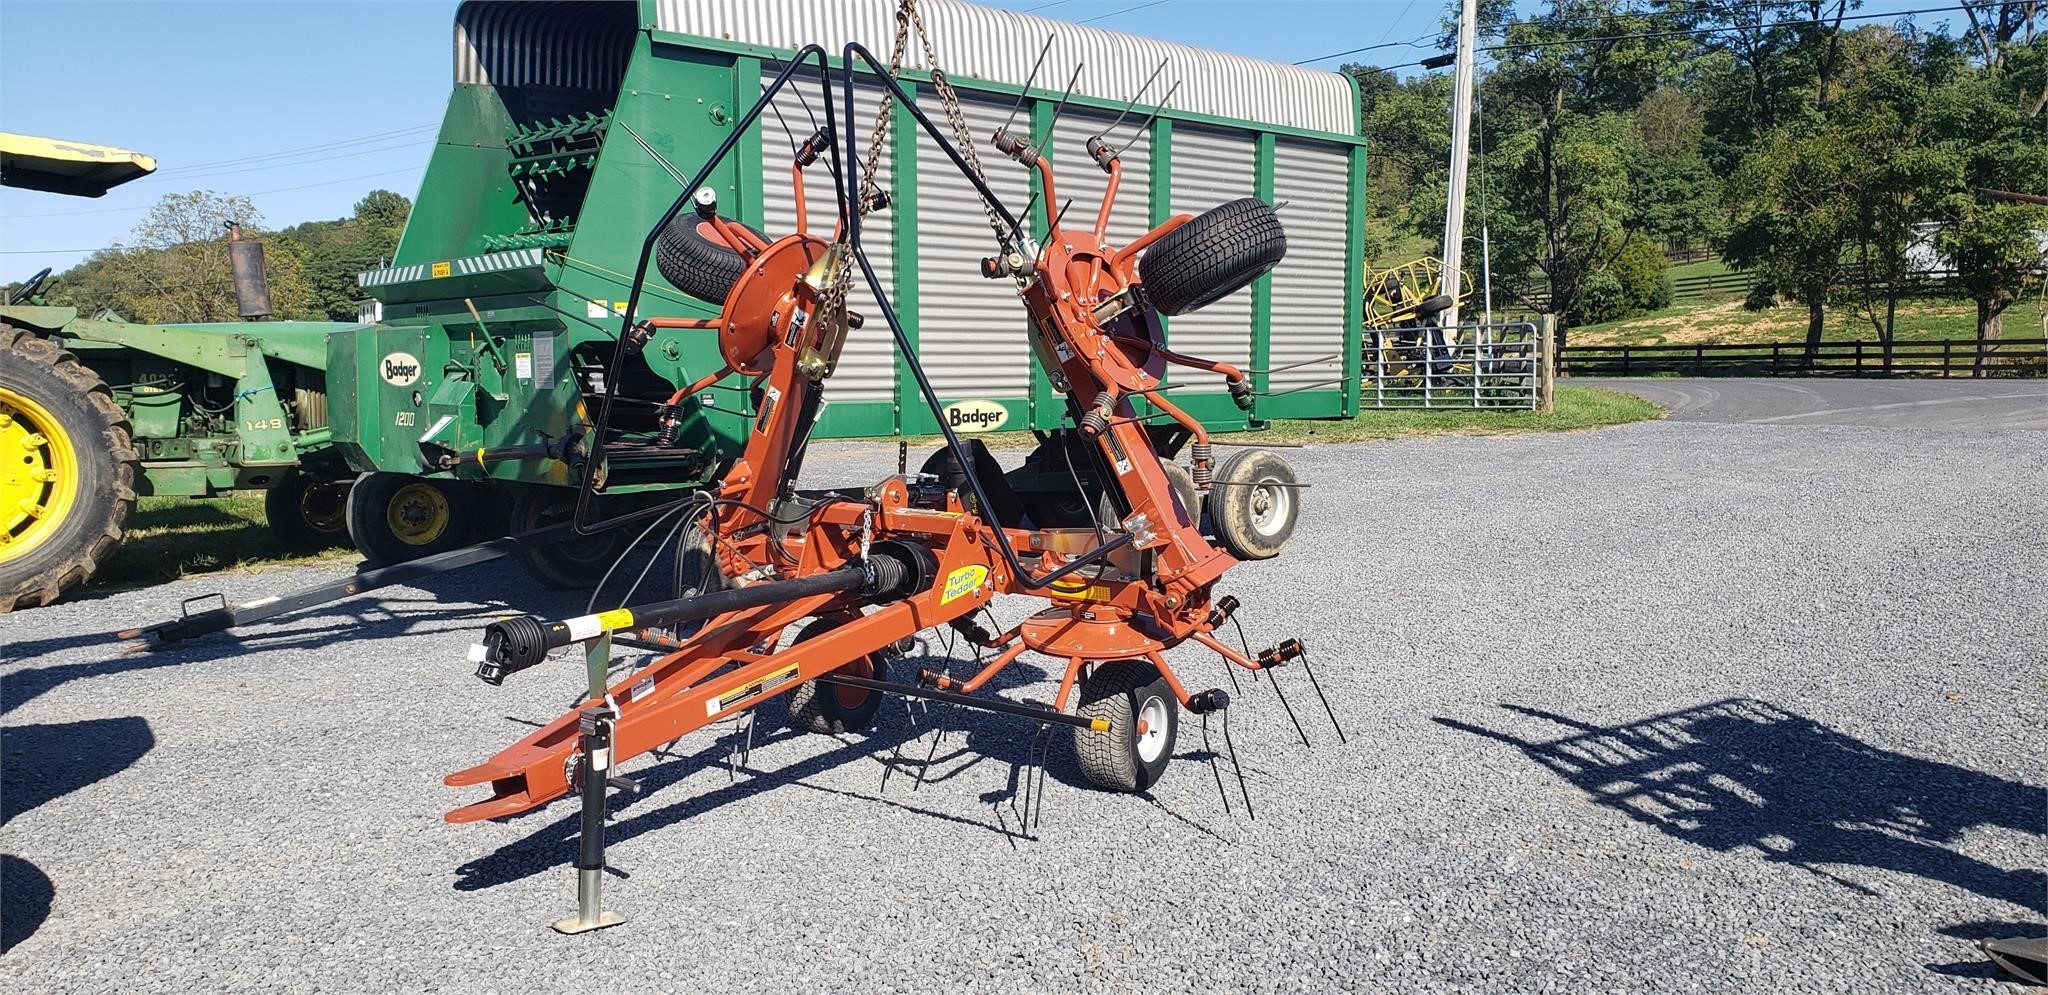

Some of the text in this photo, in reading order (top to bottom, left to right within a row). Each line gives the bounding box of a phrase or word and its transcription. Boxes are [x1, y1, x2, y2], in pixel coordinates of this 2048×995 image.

[385, 359, 418, 383] Badger
[395, 411, 416, 427] 1200
[950, 407, 1003, 428] Badger
[949, 568, 976, 587] Turbo
[945, 577, 978, 600] Tedder
